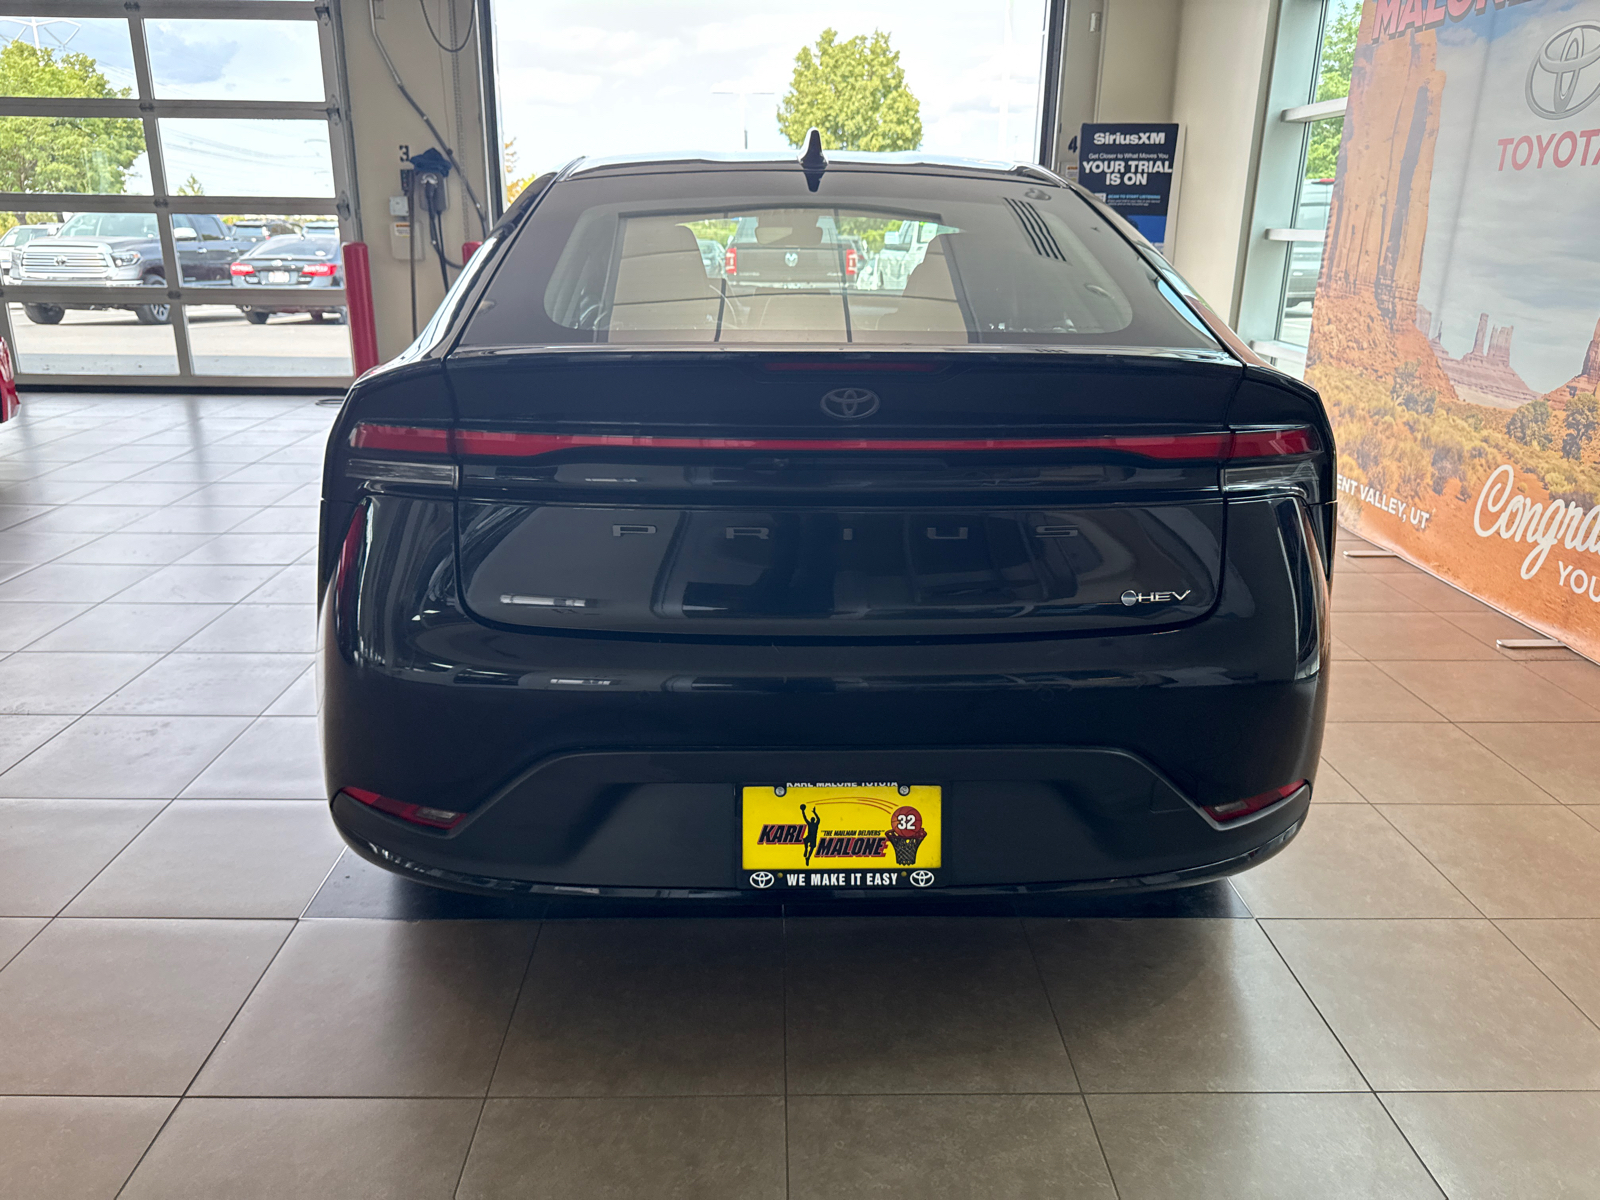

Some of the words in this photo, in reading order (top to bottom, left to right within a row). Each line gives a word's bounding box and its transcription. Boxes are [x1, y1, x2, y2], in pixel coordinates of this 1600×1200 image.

[1068, 135, 1078, 153] 4
[1093, 132, 1166, 145] SiriusXM
[399, 145, 409, 162] 3
[1082, 161, 1125, 173] YOUR
[1128, 161, 1173, 173] TRIAL
[1105, 173, 1121, 185] IS
[1123, 173, 1148, 185] ON
[1360, 484, 1407, 523] VALLEY,
[1410, 506, 1430, 529] UT
[612, 524, 1079, 540] PRIUS
[897, 814, 916, 830] 32
[757, 824, 807, 845] KARL
[833, 829, 856, 837] MAILMAN
[814, 837, 888, 858] MALONE
[787, 873, 806, 886] WE
[810, 873, 846, 886] MAKE
[850, 873, 862, 886] IT
[866, 872, 898, 885] EASY
